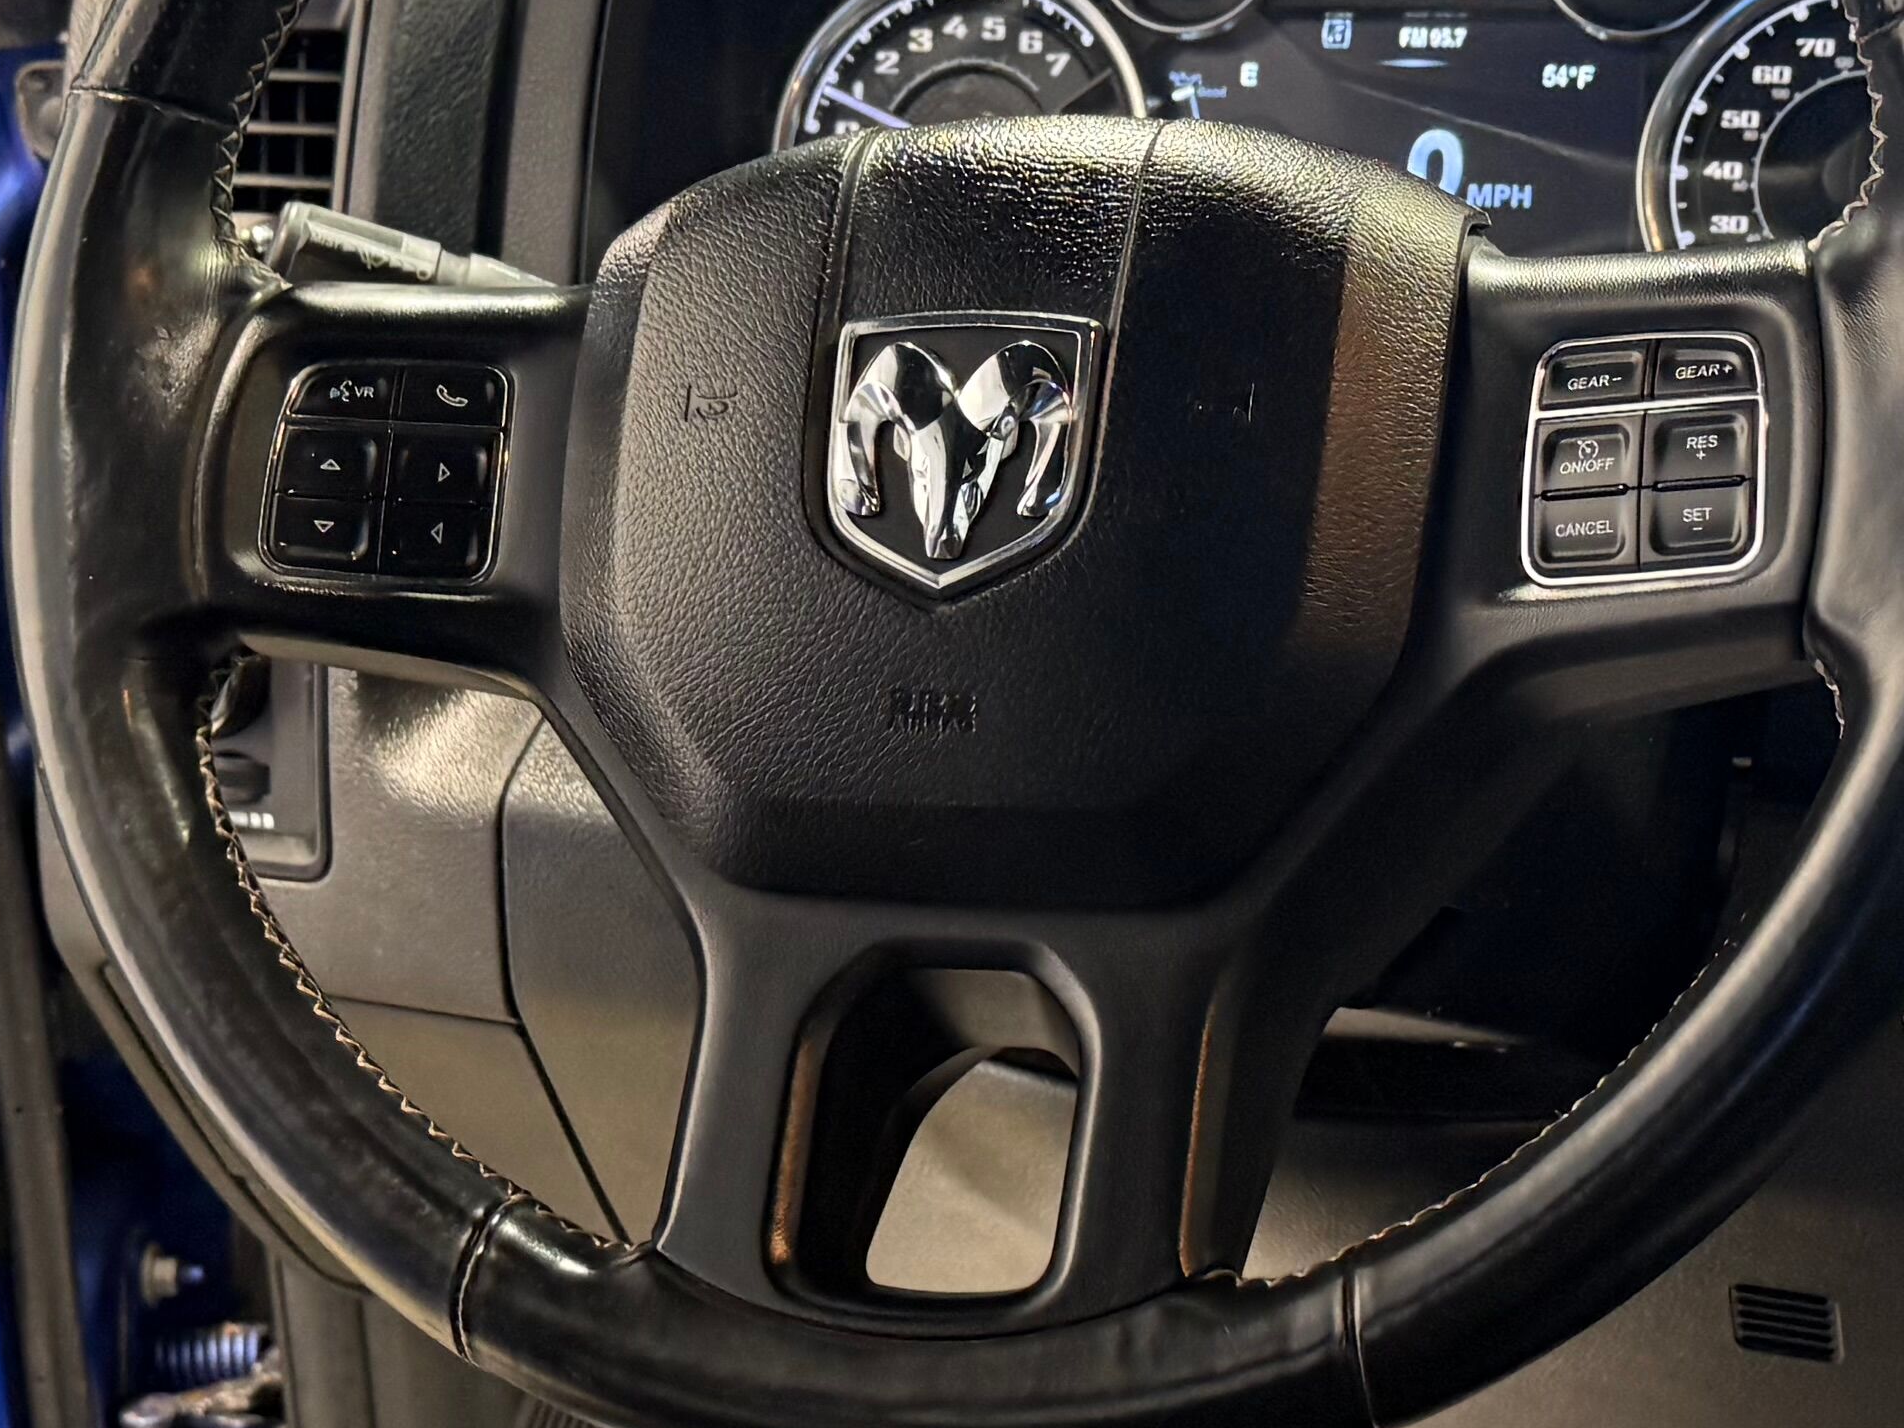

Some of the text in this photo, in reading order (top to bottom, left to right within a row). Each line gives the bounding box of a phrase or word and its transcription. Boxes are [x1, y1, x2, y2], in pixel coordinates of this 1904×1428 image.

[942, 14, 968, 40] 4
[980, 15, 1007, 42] 5
[907, 27, 933, 54] 3
[1018, 29, 1044, 55] 6
[1795, 37, 1836, 58] 70
[874, 50, 900, 75] 2
[1044, 51, 1072, 77] 7
[1751, 64, 1793, 85] 60
[1719, 109, 1761, 130] 50
[1702, 160, 1744, 181] 40
[1466, 182, 1533, 210] MPH
[1708, 214, 1749, 235] 30
[354, 385, 375, 399] VR
[1686, 435, 1719, 449] RES
[1559, 457, 1615, 475] ON/OFF
[1682, 507, 1713, 522] SET
[1555, 520, 1614, 538] CANCEL
